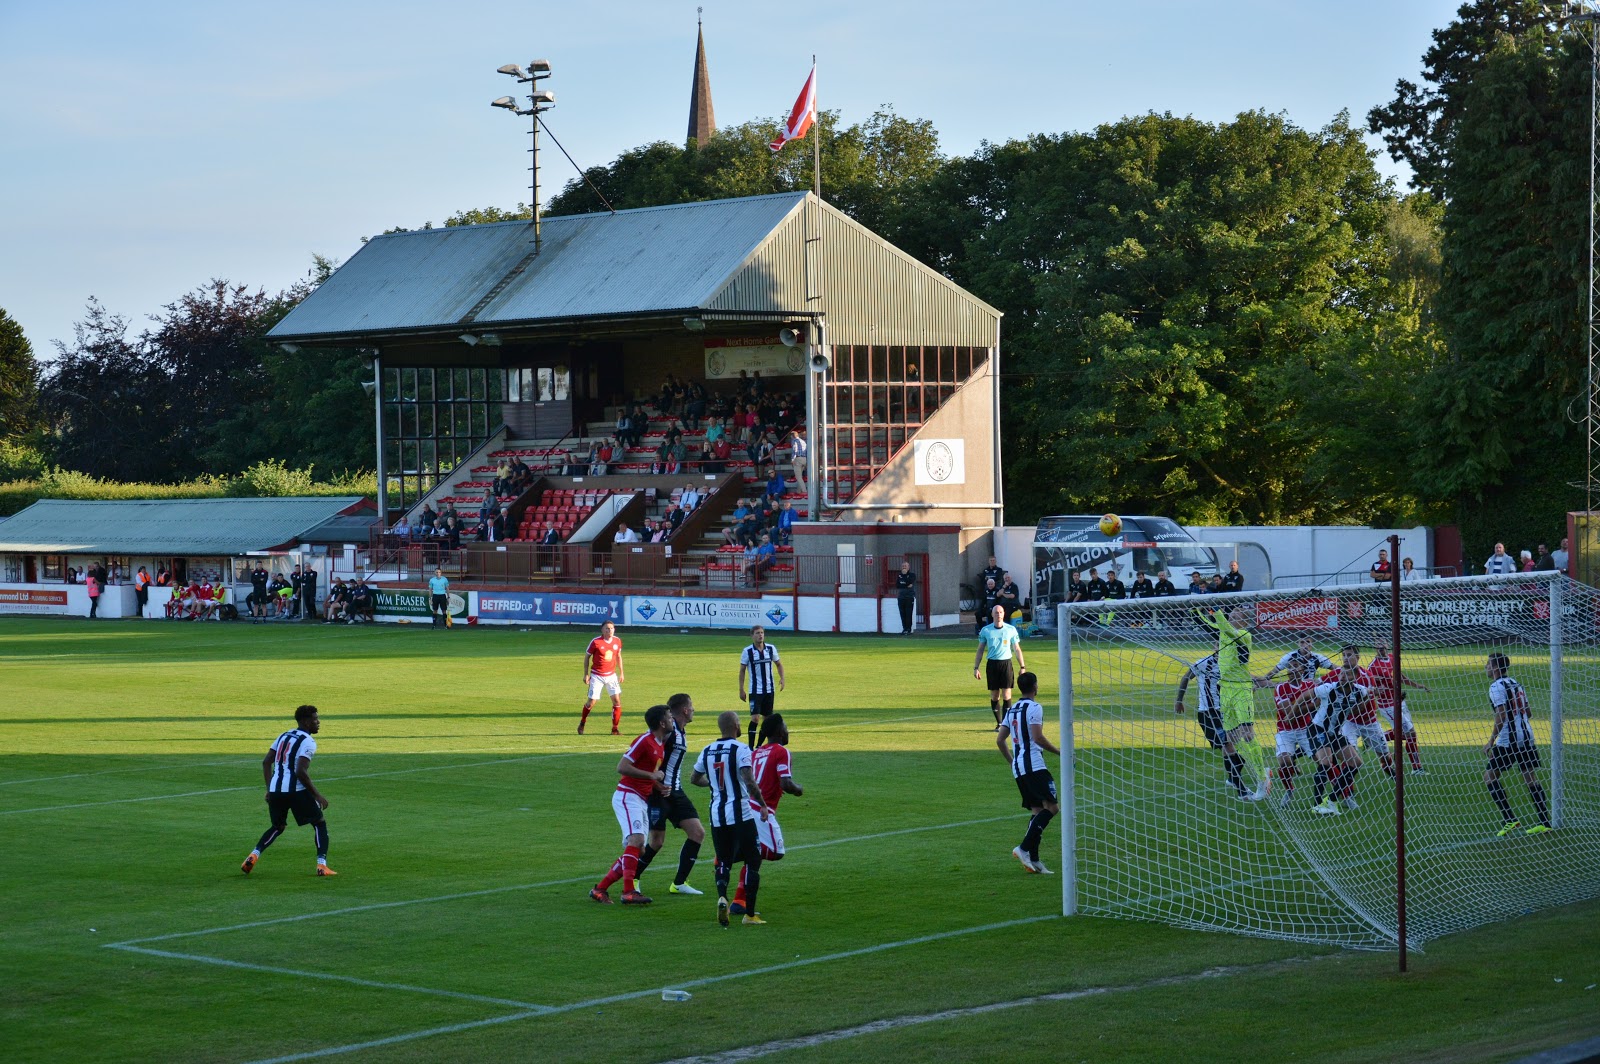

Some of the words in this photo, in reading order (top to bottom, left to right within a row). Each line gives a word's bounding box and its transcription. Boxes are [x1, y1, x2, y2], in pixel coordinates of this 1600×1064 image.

[726, 338, 742, 347] Next
[743, 337, 763, 346] Home
[764, 336, 781, 345] Gam
[19, 592, 29, 601] Ltd
[395, 594, 426, 607] FRASER
[481, 599, 521, 611] BETFRED
[521, 603, 533, 611] CUP
[554, 601, 596, 614] BETFRED
[596, 606, 608, 614] CUP
[662, 601, 675, 620] A
[675, 601, 717, 616] CRAIG
[1259, 599, 1335, 622] @brechincityfc
[1400, 601, 1422, 612] THE
[1425, 600, 1476, 612] WORLD'S
[1480, 600, 1525, 612] SAFETY
[1400, 614, 1459, 625] TRAINING
[713, 761, 725, 790] 7
[752, 756, 769, 785] 17
